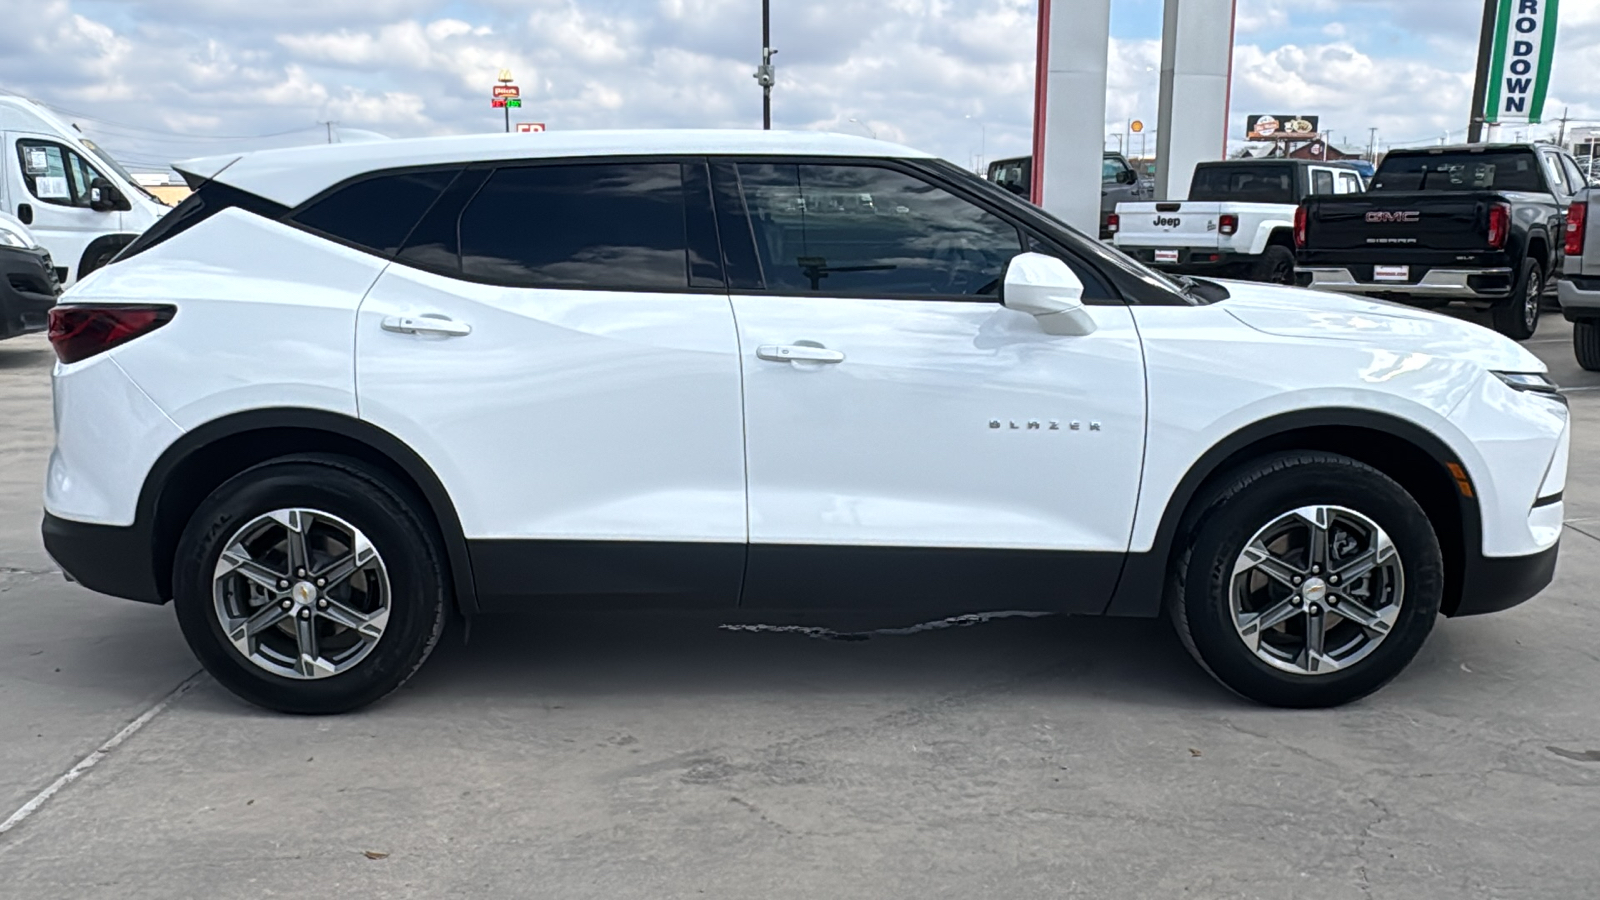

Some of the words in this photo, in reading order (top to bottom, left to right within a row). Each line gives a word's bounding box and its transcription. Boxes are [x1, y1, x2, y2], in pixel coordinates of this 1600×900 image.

[1505, 40, 1532, 112] DOWN
[1153, 215, 1180, 228] Jeep
[1365, 211, 1420, 222] GMC
[989, 420, 1101, 431] BLAZER
